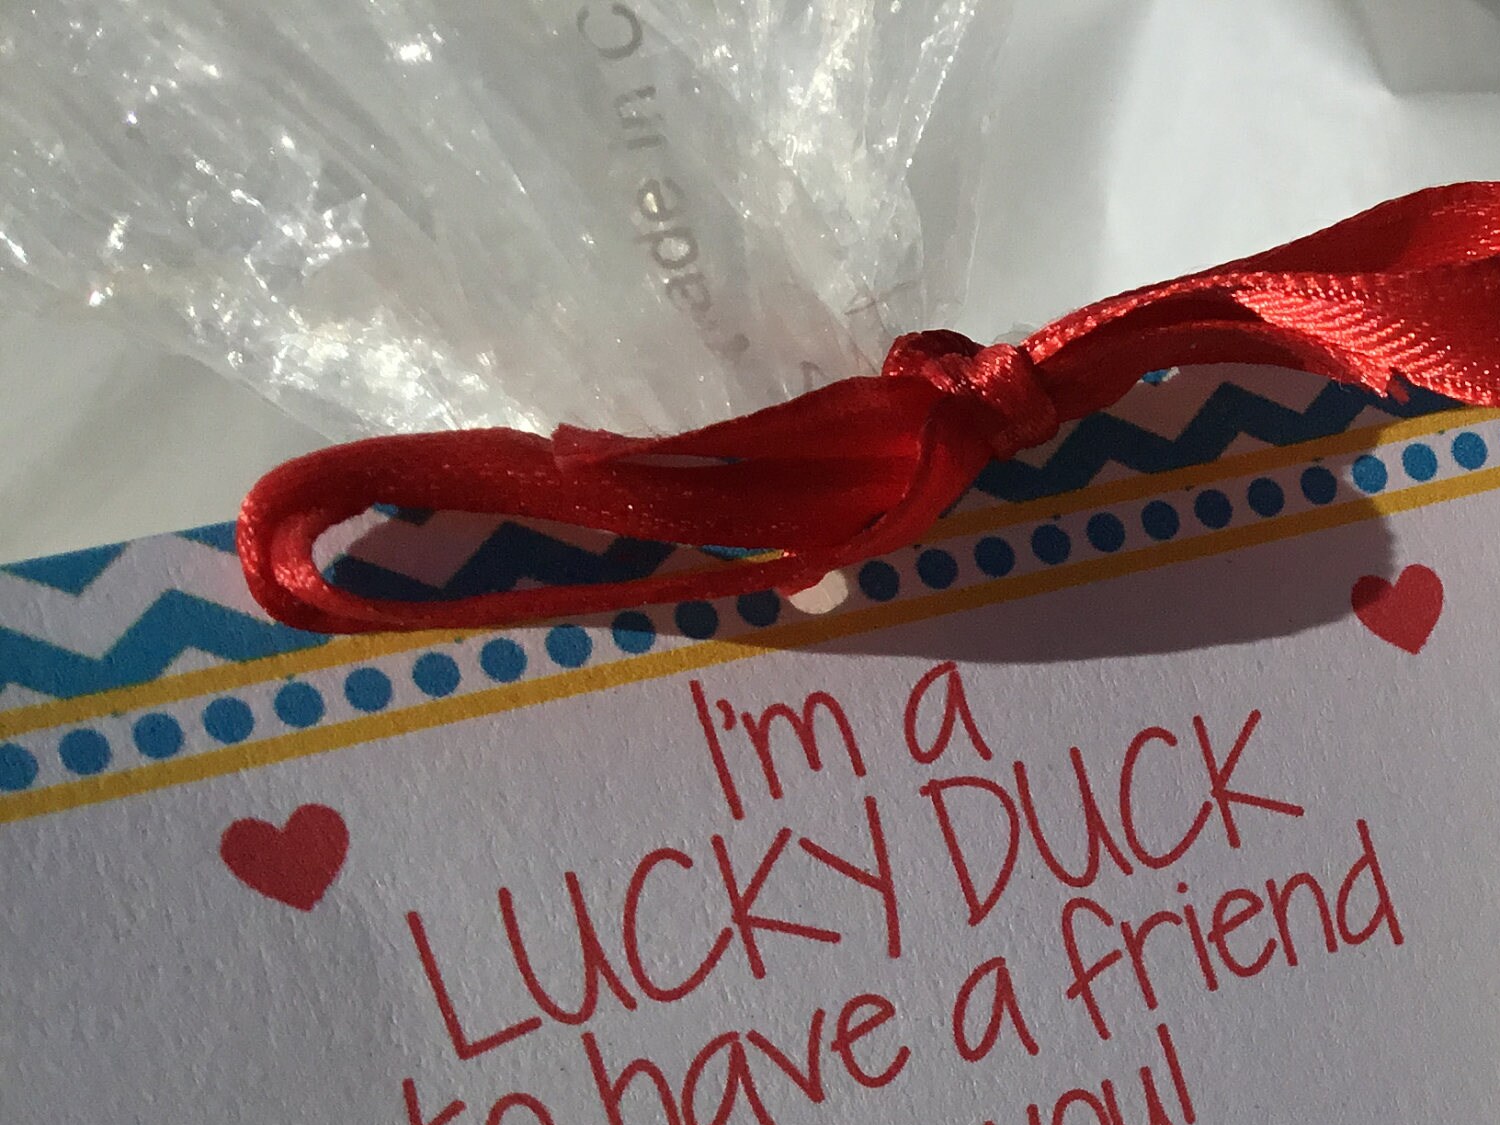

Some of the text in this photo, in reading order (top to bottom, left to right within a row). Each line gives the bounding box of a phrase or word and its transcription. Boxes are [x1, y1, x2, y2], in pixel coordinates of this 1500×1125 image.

[688, 660, 993, 821] I'm a
[406, 709, 1304, 1060] LUCKY DUCK
[951, 956, 1040, 1063] a
[1061, 819, 1404, 1040] friend
